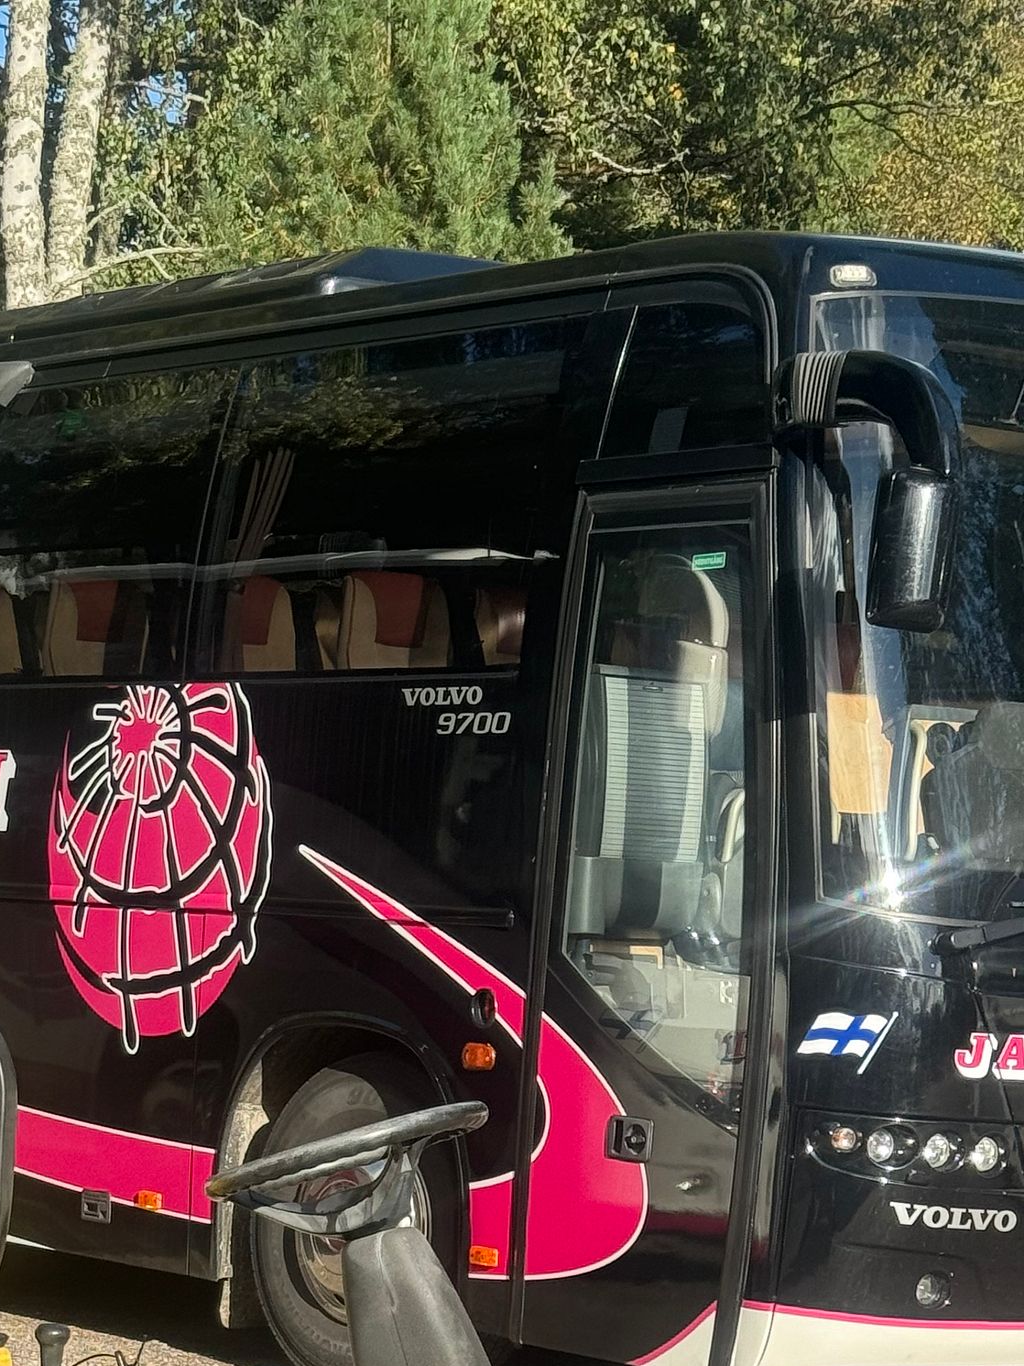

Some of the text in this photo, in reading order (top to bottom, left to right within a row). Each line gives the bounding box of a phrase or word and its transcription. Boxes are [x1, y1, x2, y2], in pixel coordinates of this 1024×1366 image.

[401, 686, 483, 706] VOLVO
[437, 712, 511, 734] 9700
[889, 1202, 1017, 1233] VOLVO
